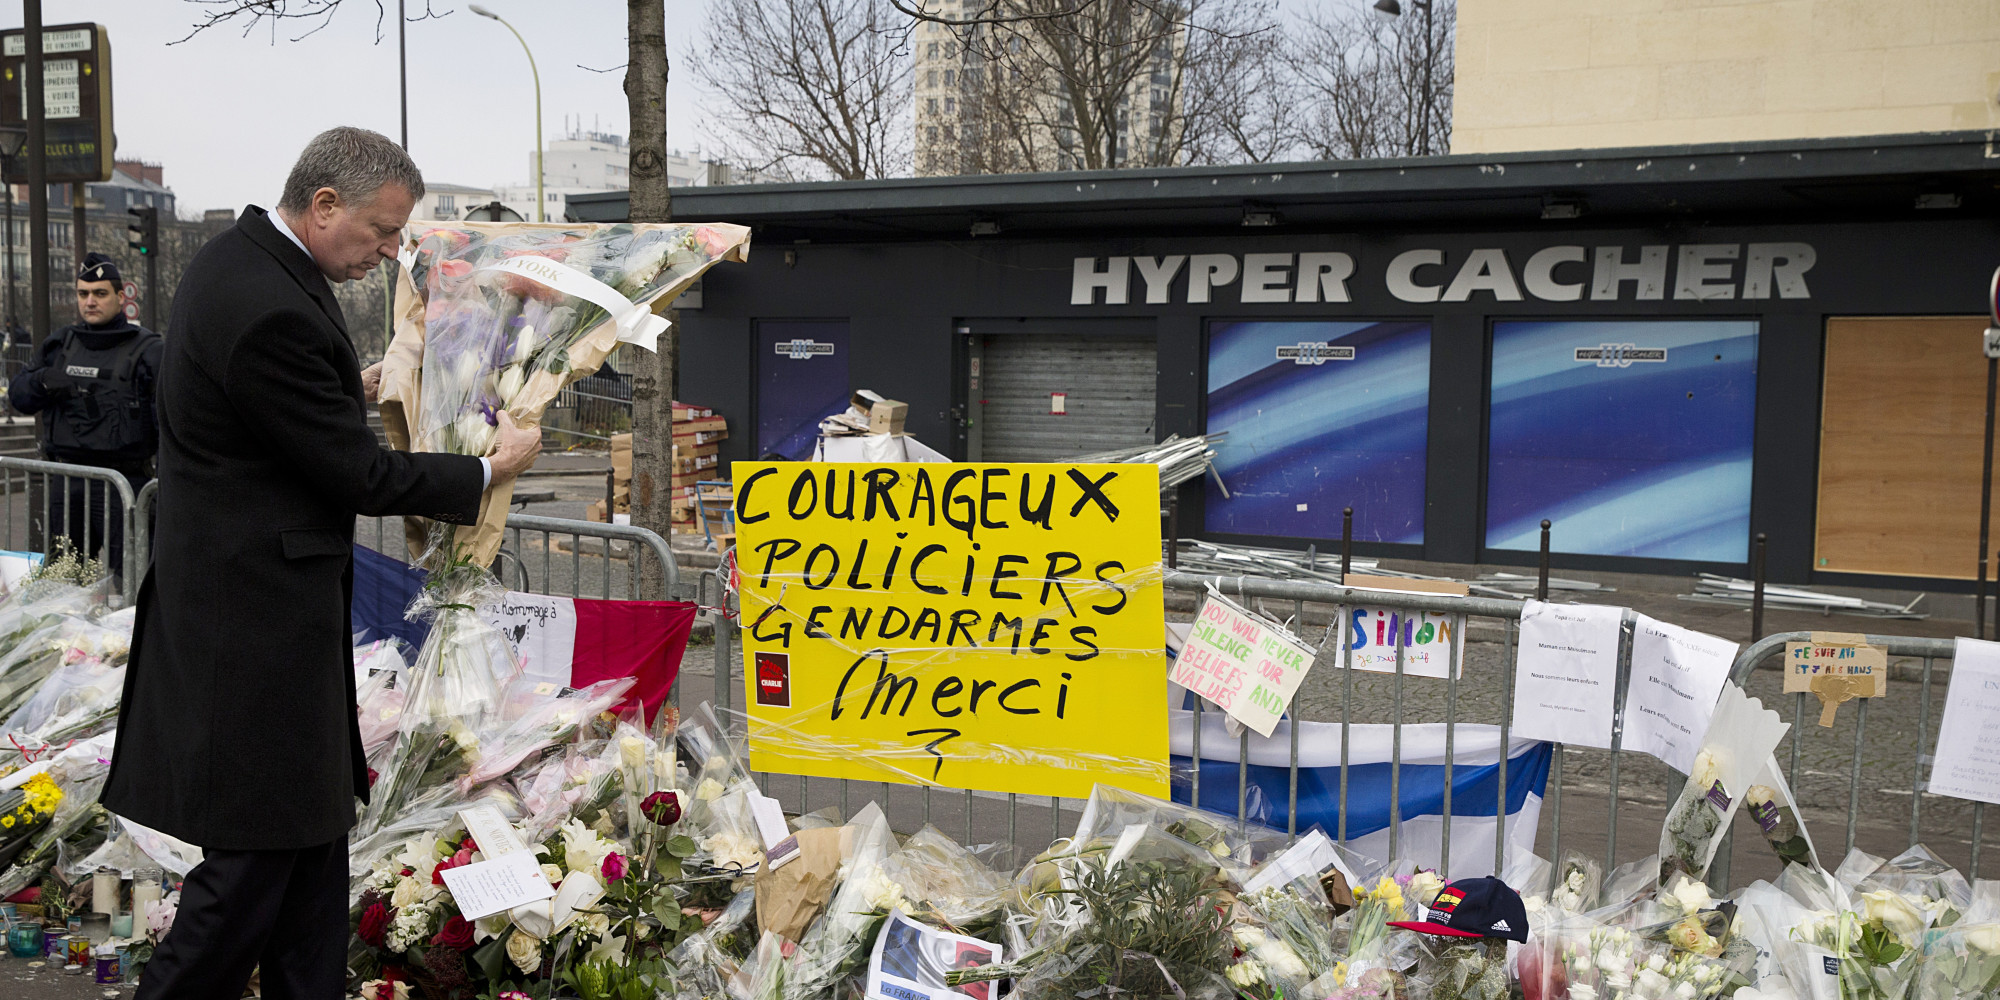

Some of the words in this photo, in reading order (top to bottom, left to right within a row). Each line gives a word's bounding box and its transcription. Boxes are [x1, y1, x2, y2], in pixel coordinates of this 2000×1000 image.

[516, 259, 565, 282] YORK
[1071, 252, 1356, 304] HYPER
[1385, 242, 1817, 303] CACHER
[69, 367, 95, 376] POLICE
[737, 467, 1120, 541] COURAGEUX
[752, 604, 1099, 661] GENDARMES
[1202, 602, 1230, 625] YOU
[1231, 617, 1261, 645] WILL
[1260, 635, 1304, 671] NEVER
[1645, 627, 1654, 635] La
[1655, 630, 1676, 641] France
[1567, 646, 1597, 655] Musulmane
[1794, 646, 1811, 659] JE
[1257, 659, 1284, 685] OUR
[1795, 664, 1809, 674] ET
[761, 679, 783, 688] CHARLIE
[831, 649, 1072, 720] Merci
[1176, 663, 1237, 710] VALUES
[1580, 678, 1599, 686] enfants
[1648, 675, 1661, 684] Elle
[1248, 684, 1284, 716] AND
[1639, 705, 1657, 716] Leurs
[880, 984, 892, 994] La
